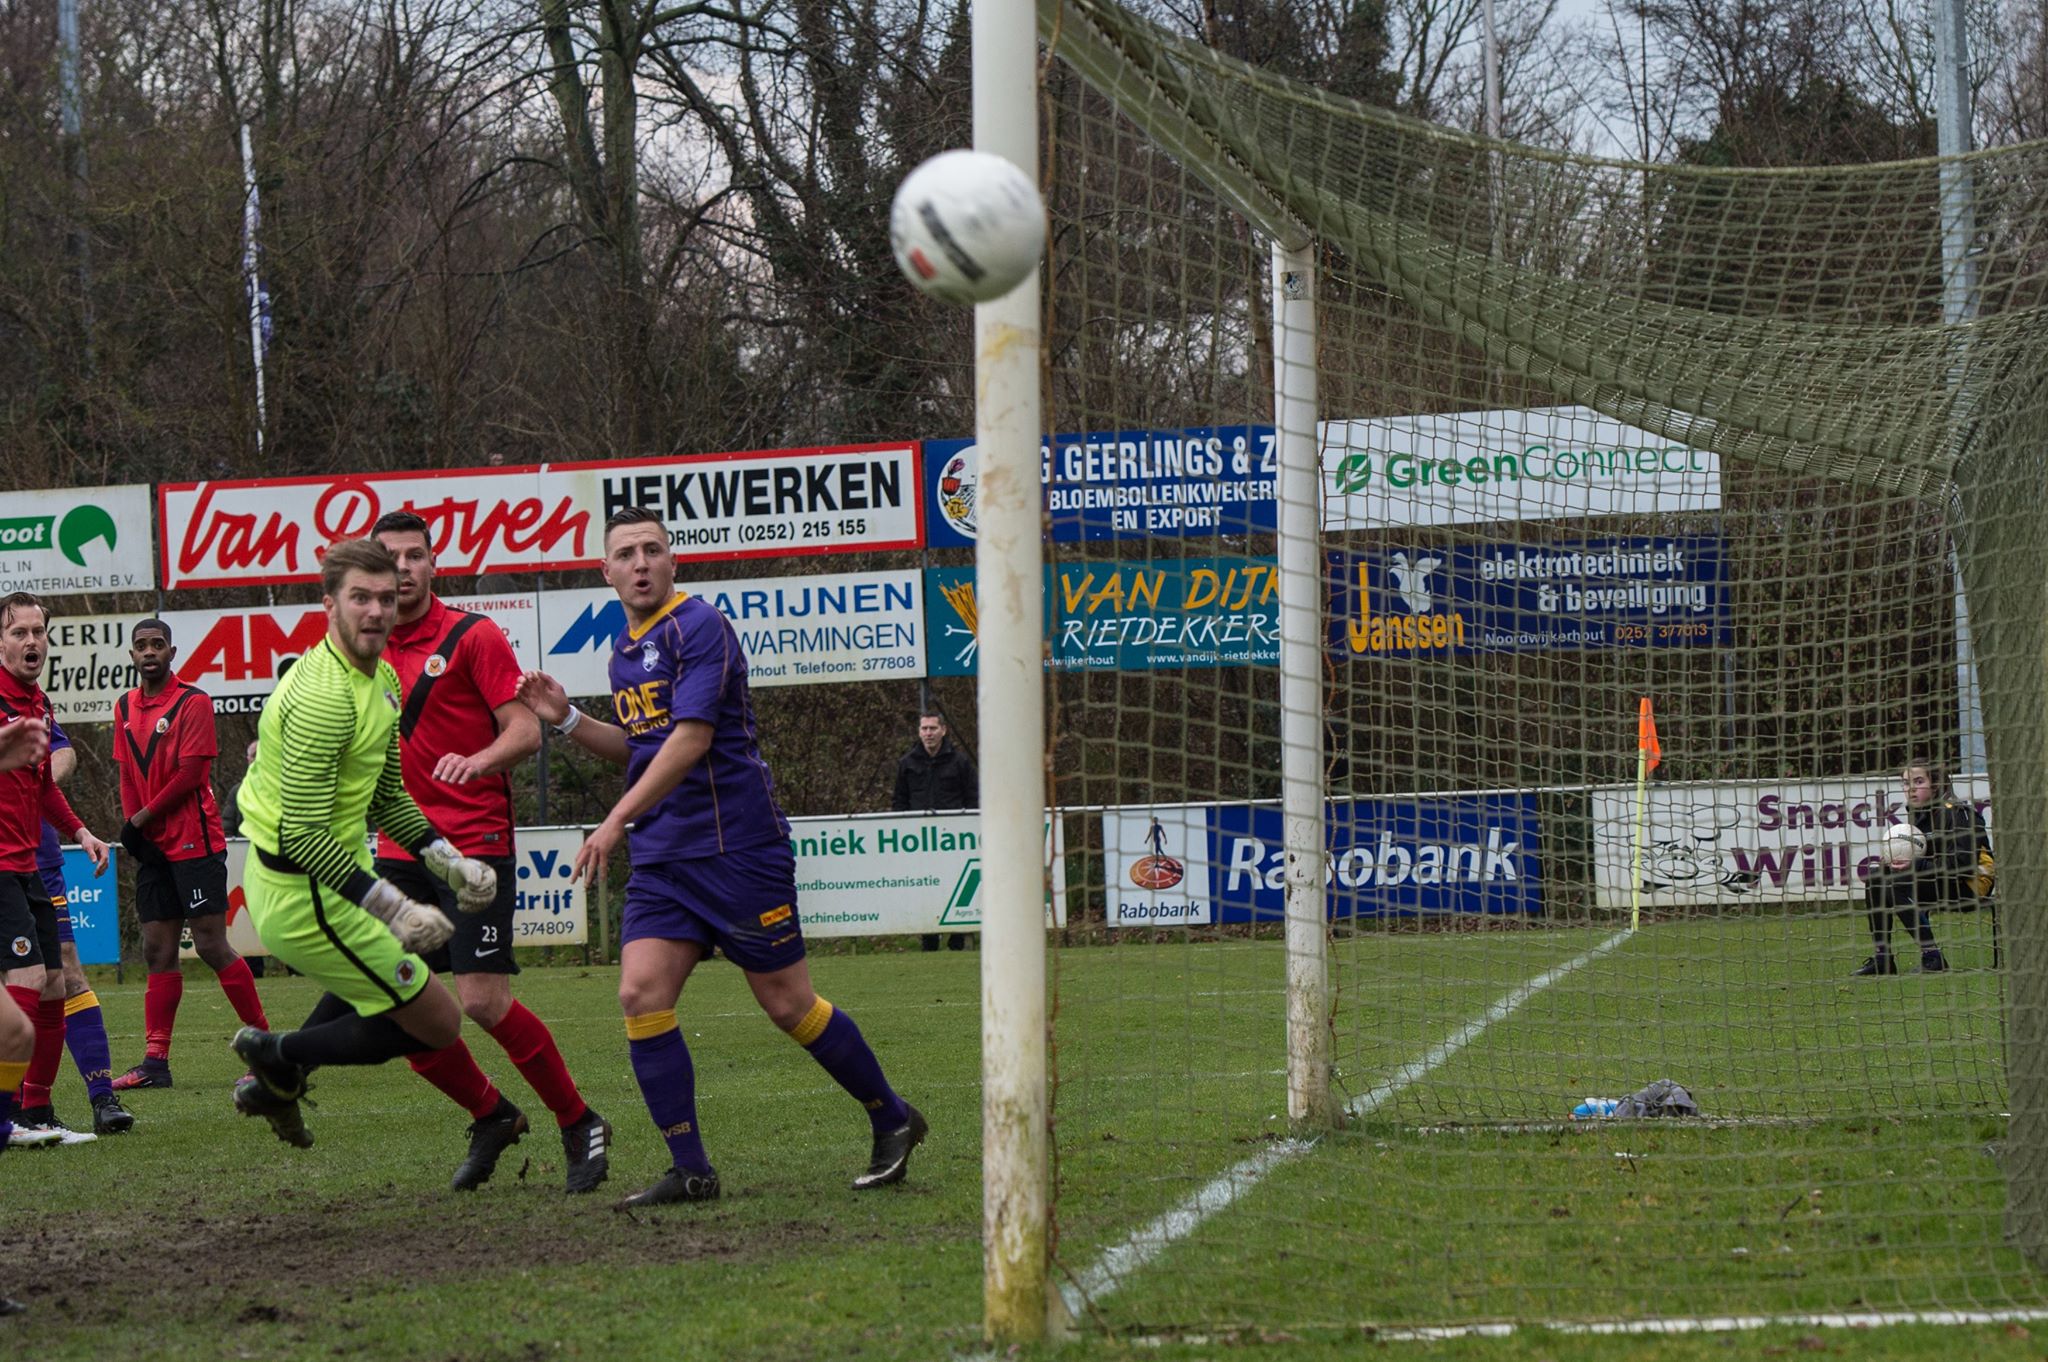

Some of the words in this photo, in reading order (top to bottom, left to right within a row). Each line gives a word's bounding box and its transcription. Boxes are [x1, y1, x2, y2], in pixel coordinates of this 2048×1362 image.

[1232, 436, 1251, 474] &
[1385, 445, 1703, 488] GreenConnect
[603, 460, 901, 521] HEKWERKEN
[178, 481, 300, 574] Van
[739, 521, 795, 543] (0252)
[803, 521, 830, 538] 215
[838, 519, 866, 536] 155
[1112, 510, 1138, 530] EN
[1147, 506, 1222, 530] EXPORT
[18, 561, 32, 573] IN
[1480, 544, 1683, 581] elektrotechniek
[110, 574, 137, 587] B.V.
[1061, 570, 1166, 614] VAN
[694, 582, 913, 620] ARIJNEN
[1350, 561, 1465, 653] Janssen
[1537, 585, 1559, 613] &
[1566, 578, 1707, 615] beveiliging
[1485, 629, 1605, 647] Noordwijkerhout
[1615, 626, 1650, 640] 0252
[748, 664, 786, 678] rhout
[793, 659, 857, 675] Telefoon:
[863, 656, 916, 671] 377808
[74, 701, 112, 713] 02973
[1758, 790, 1903, 831] Snack
[877, 826, 981, 854] Hollan
[193, 889, 202, 900] 11
[799, 911, 879, 924] achinebouw
[1119, 899, 1200, 918] Rabobank
[482, 926, 498, 942] 23
